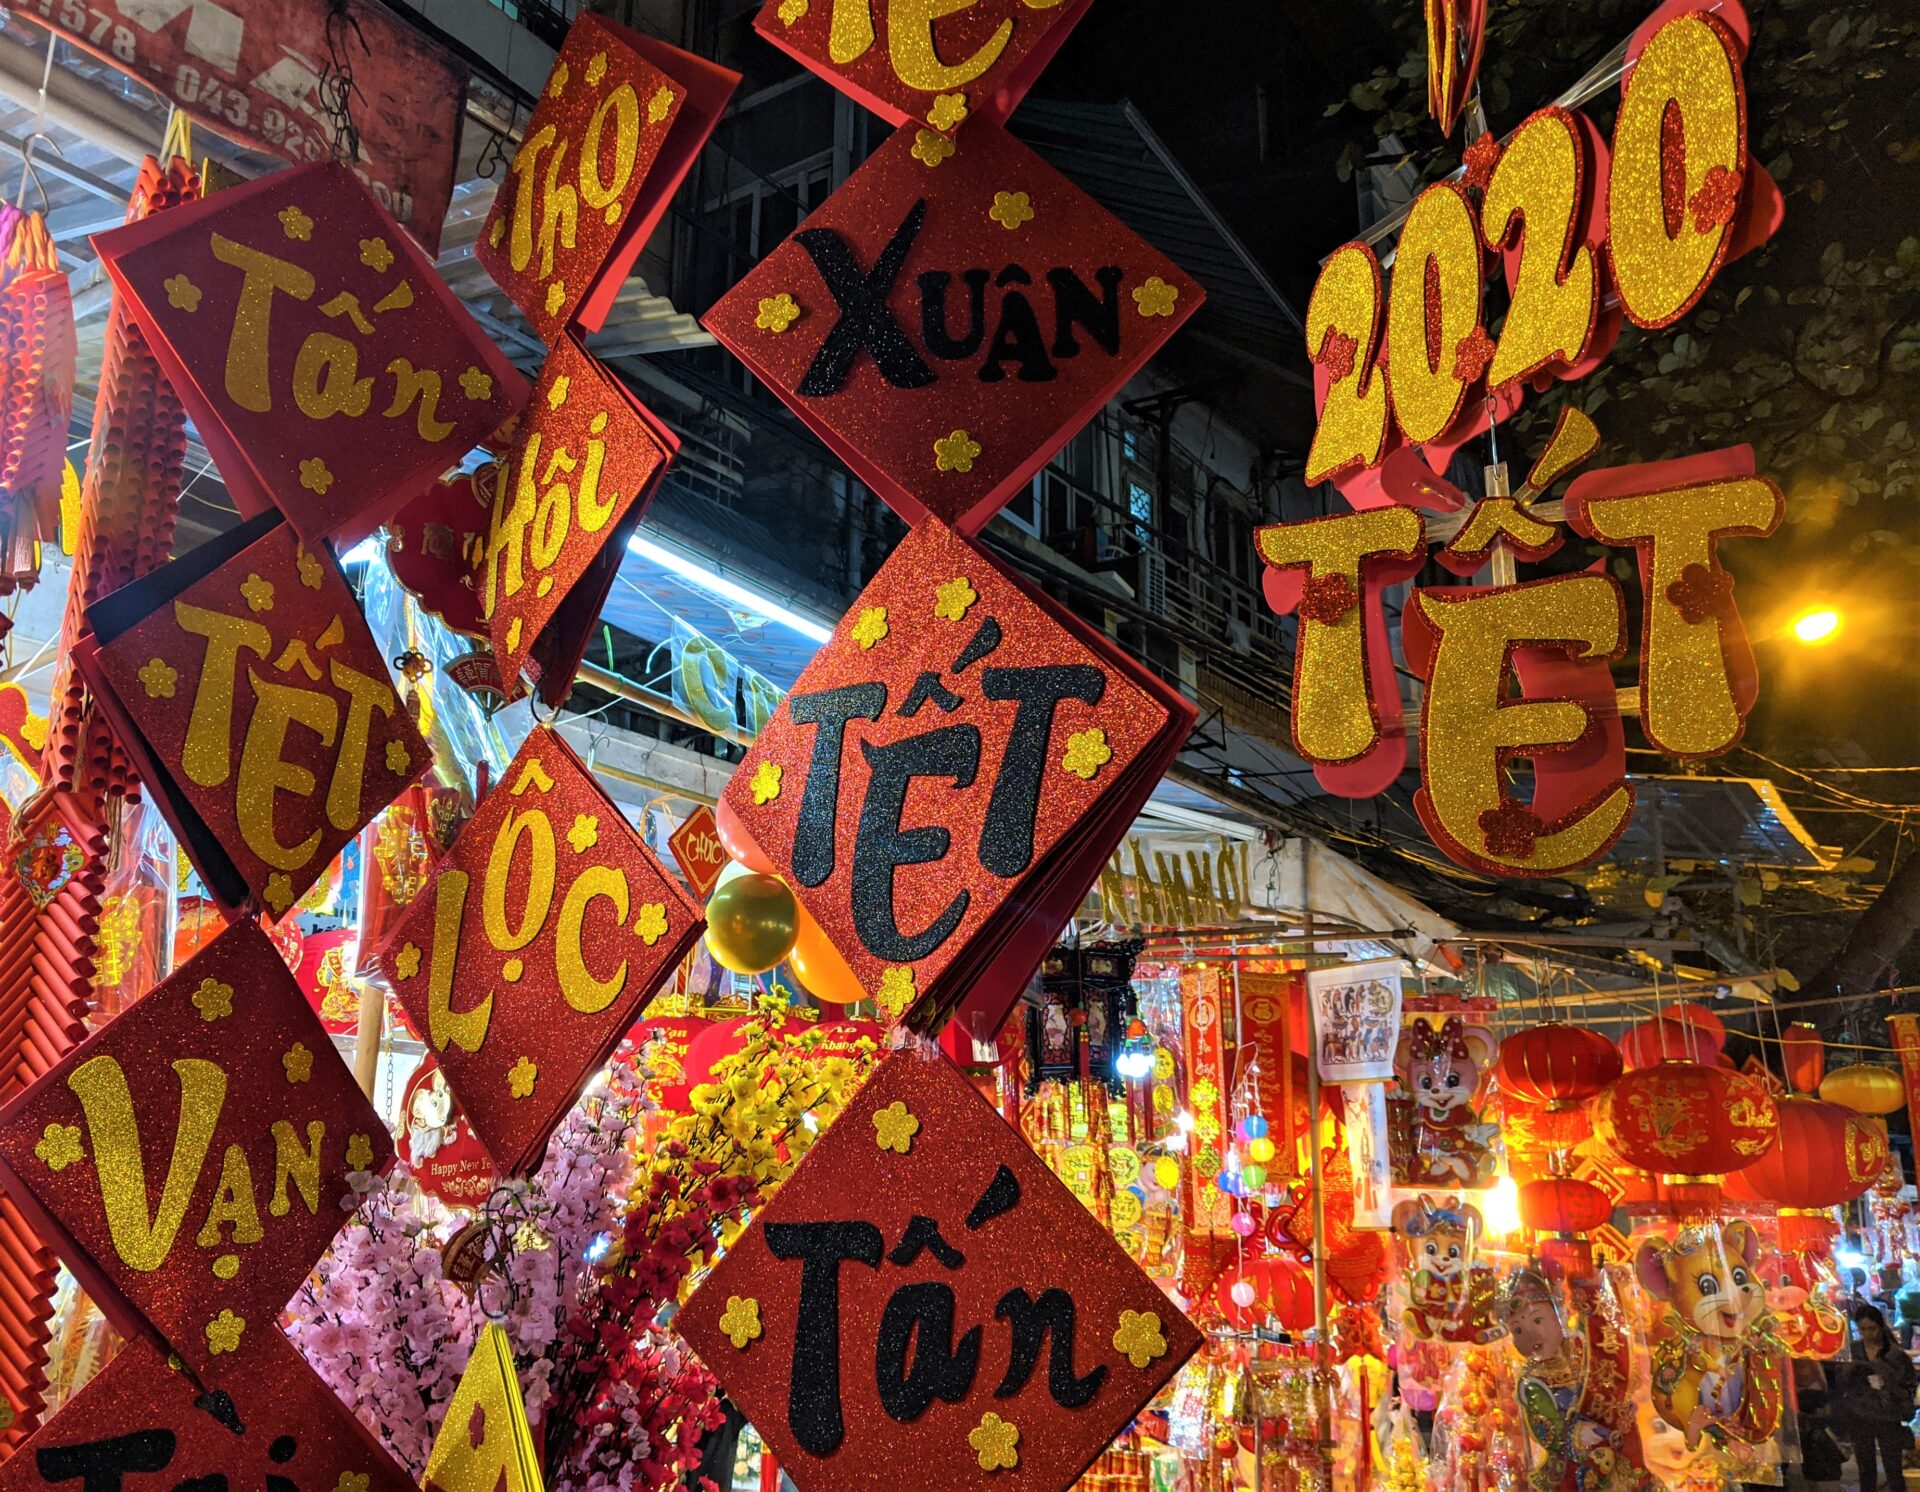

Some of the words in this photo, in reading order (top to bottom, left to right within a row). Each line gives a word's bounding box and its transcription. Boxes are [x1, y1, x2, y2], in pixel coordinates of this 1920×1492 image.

[210, 231, 458, 442] Tấn
[793, 198, 1124, 398] XUÂN
[1304, 10, 1748, 488] 2020
[174, 600, 394, 872] TẾT
[1254, 404, 1786, 879] TẾT
[428, 758, 631, 1053] LỘC
[790, 616, 1106, 963] TẾT
[68, 1055, 326, 1280] VẠN
[430, 1162, 458, 1178] Happy
[460, 1160, 478, 1172] New
[481, 1156, 493, 1170] Ye
[763, 1163, 1107, 1456] Tấn
